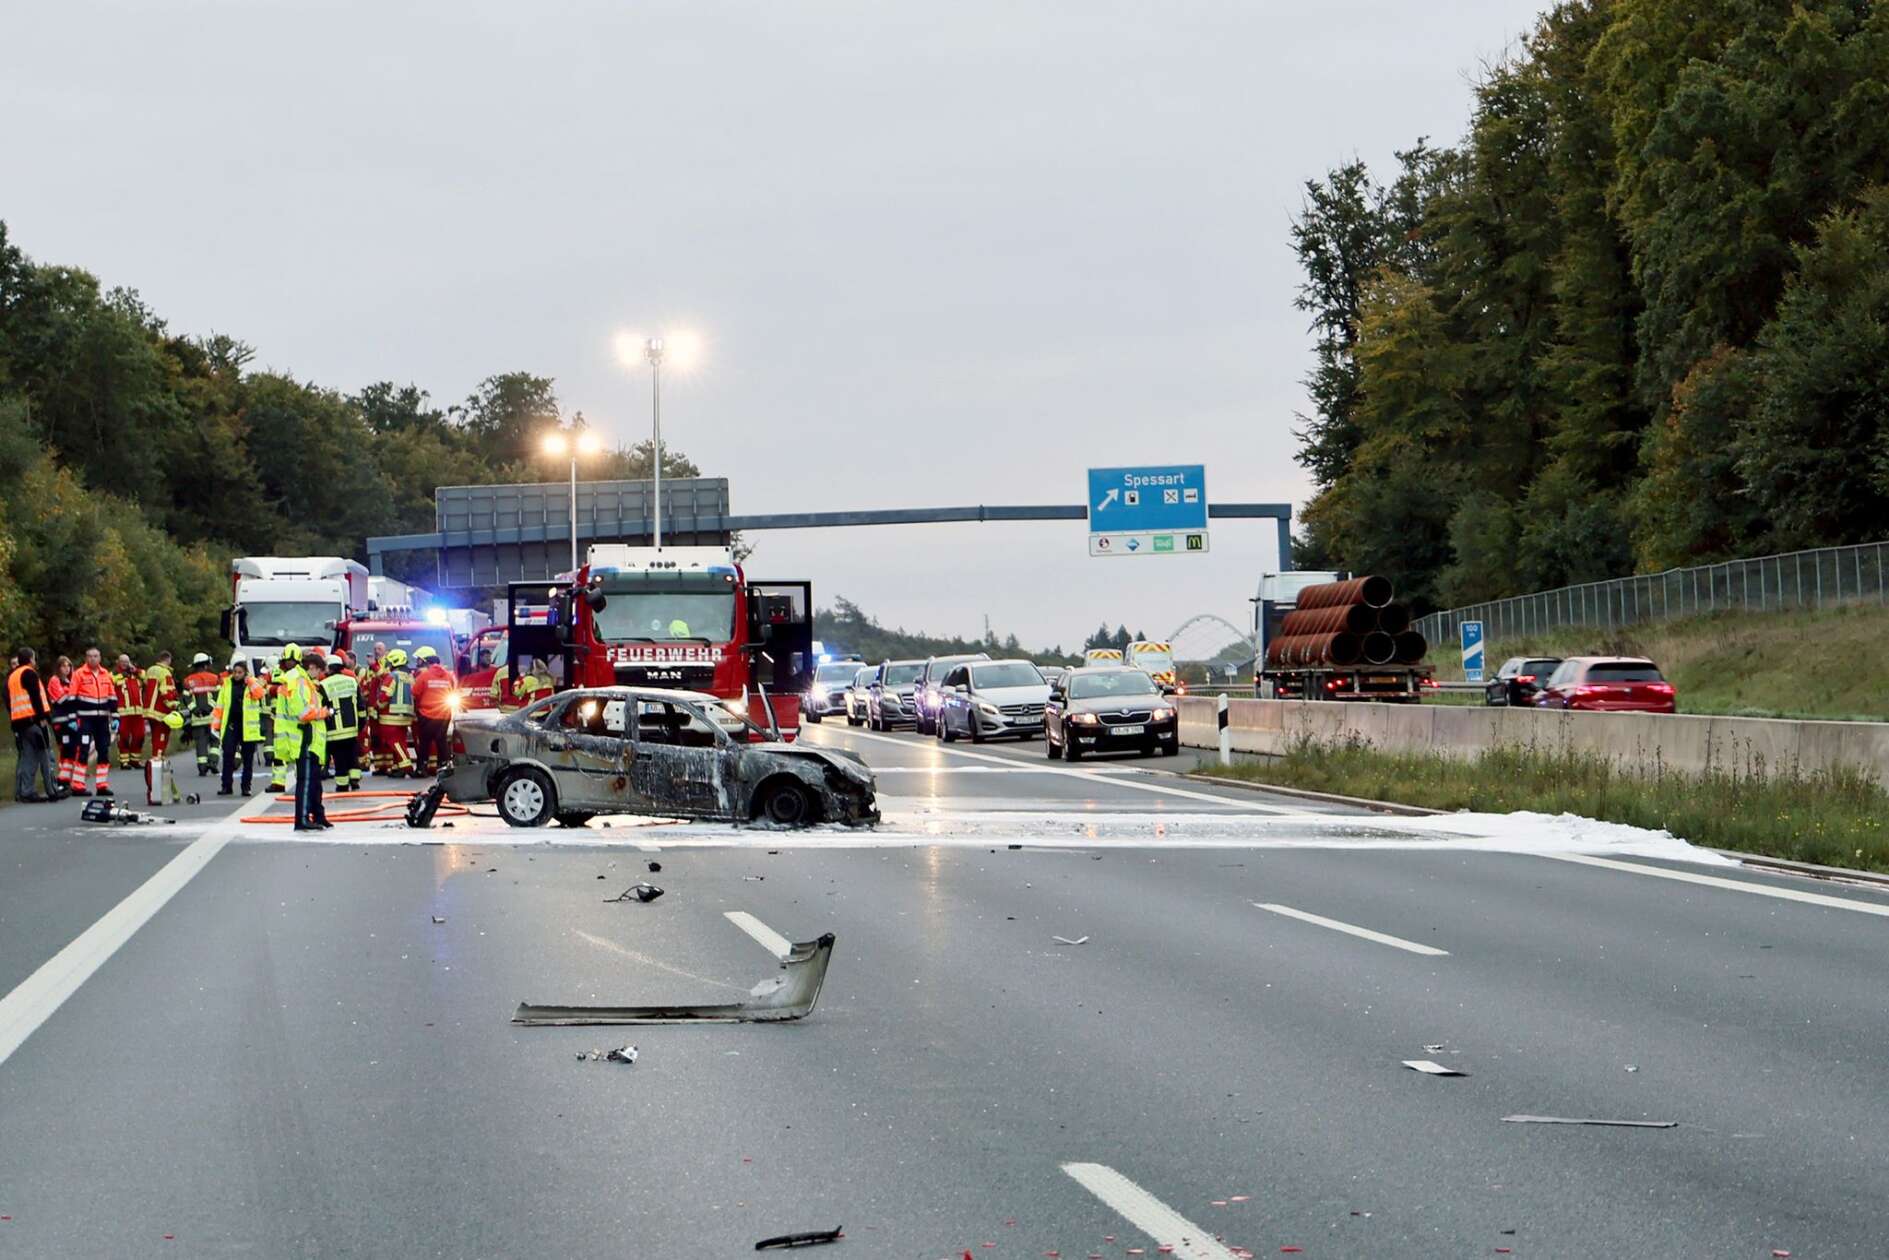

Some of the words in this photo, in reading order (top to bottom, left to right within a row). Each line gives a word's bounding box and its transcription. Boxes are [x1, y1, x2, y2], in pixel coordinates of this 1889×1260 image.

[1124, 472, 1184, 488] Spessart
[606, 648, 722, 662] FEUERWEHR
[646, 671, 682, 680] MAN
